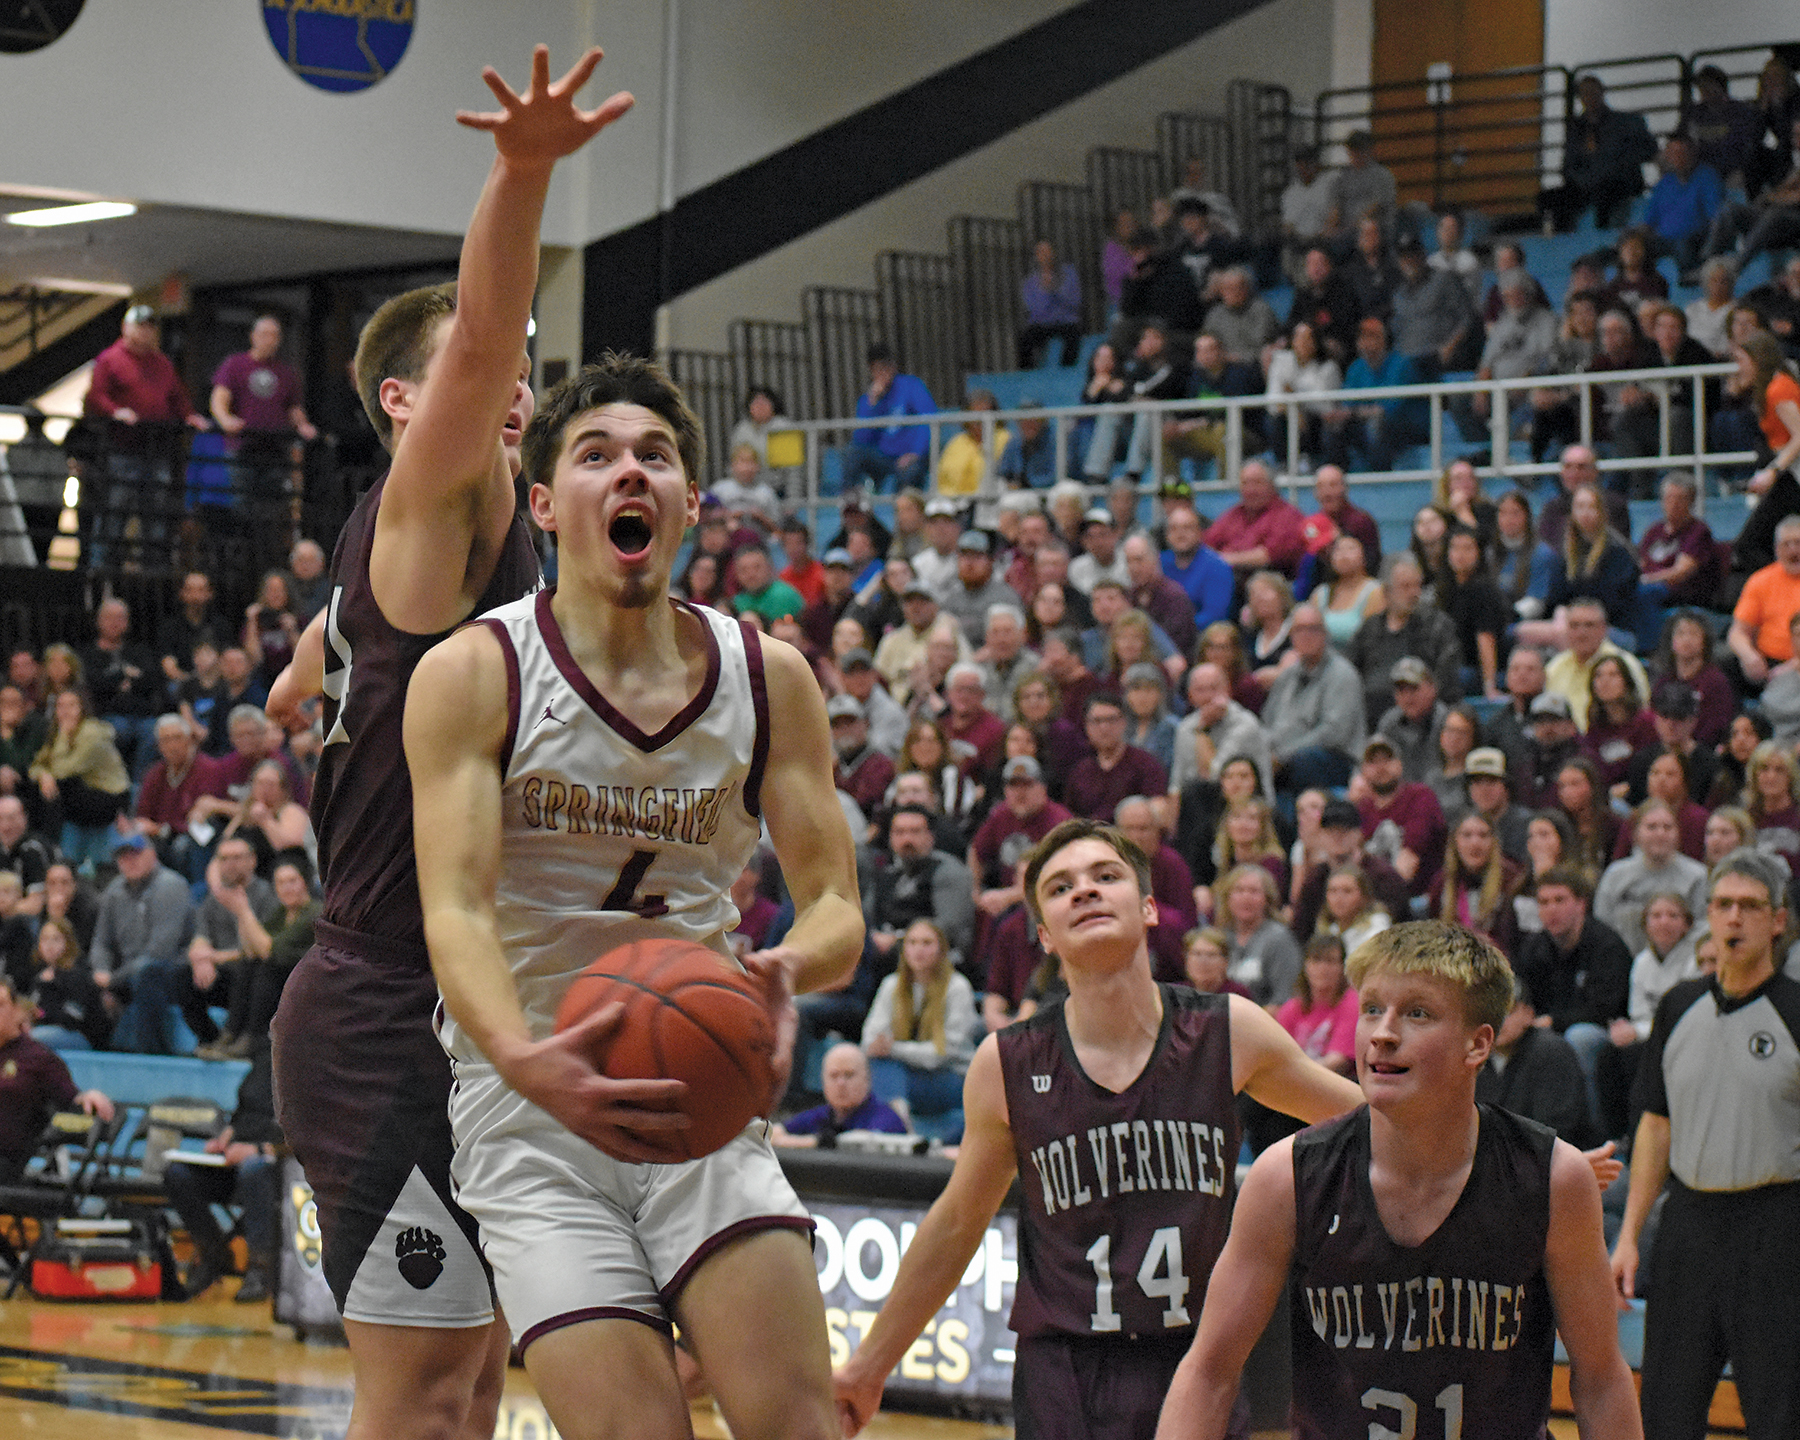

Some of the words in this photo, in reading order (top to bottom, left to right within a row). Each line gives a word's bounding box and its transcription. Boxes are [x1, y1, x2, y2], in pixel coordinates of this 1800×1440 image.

[1031, 1119, 1225, 1216] WOLVERINES
[1085, 1226, 1191, 1332] 14
[1306, 1276, 1525, 1352] WOLVERINES
